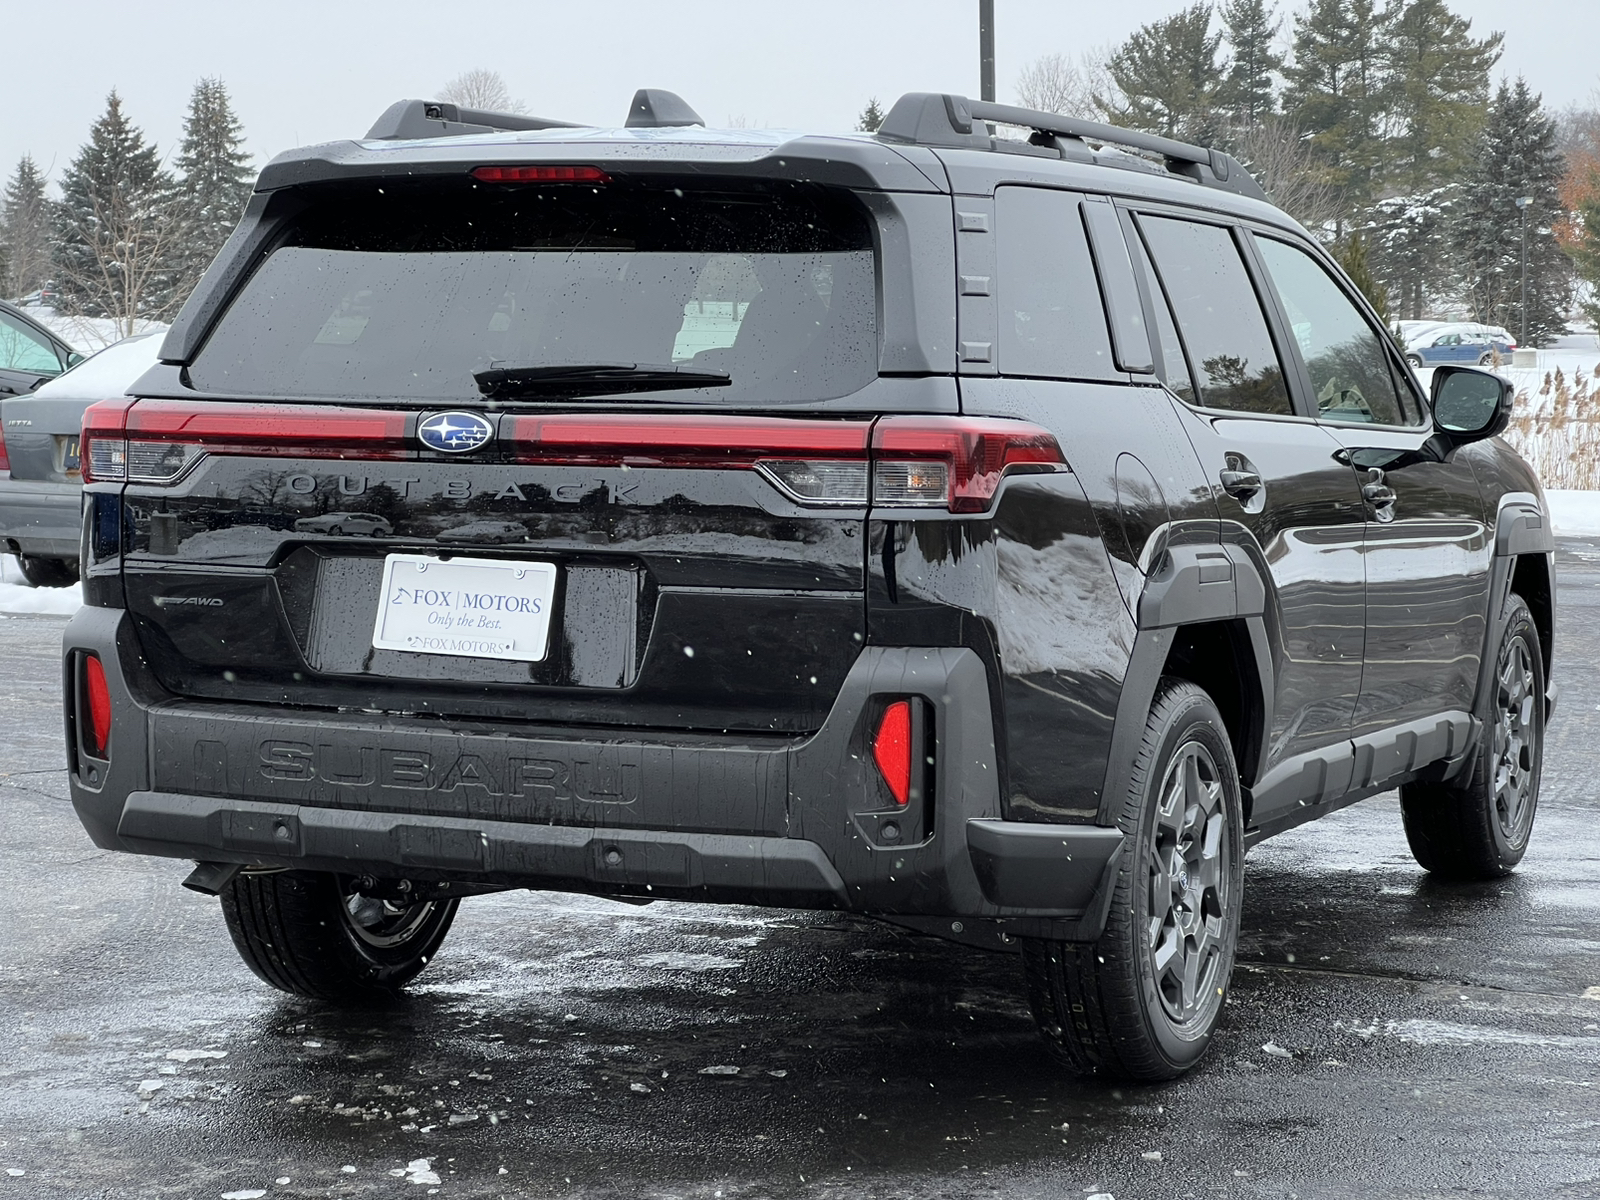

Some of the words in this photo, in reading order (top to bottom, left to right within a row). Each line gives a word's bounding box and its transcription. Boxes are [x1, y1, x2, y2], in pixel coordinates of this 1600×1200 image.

[286, 474, 640, 504] OUTBACK
[183, 597, 224, 606] AWD
[413, 589, 452, 607] FOX
[463, 593, 542, 614] MOTORS
[427, 611, 455, 629] Only
[457, 613, 474, 627] the
[477, 615, 502, 629] Best.
[422, 637, 449, 650] FOX
[449, 639, 504, 654] MOTORS
[259, 739, 638, 804] SUBARU
